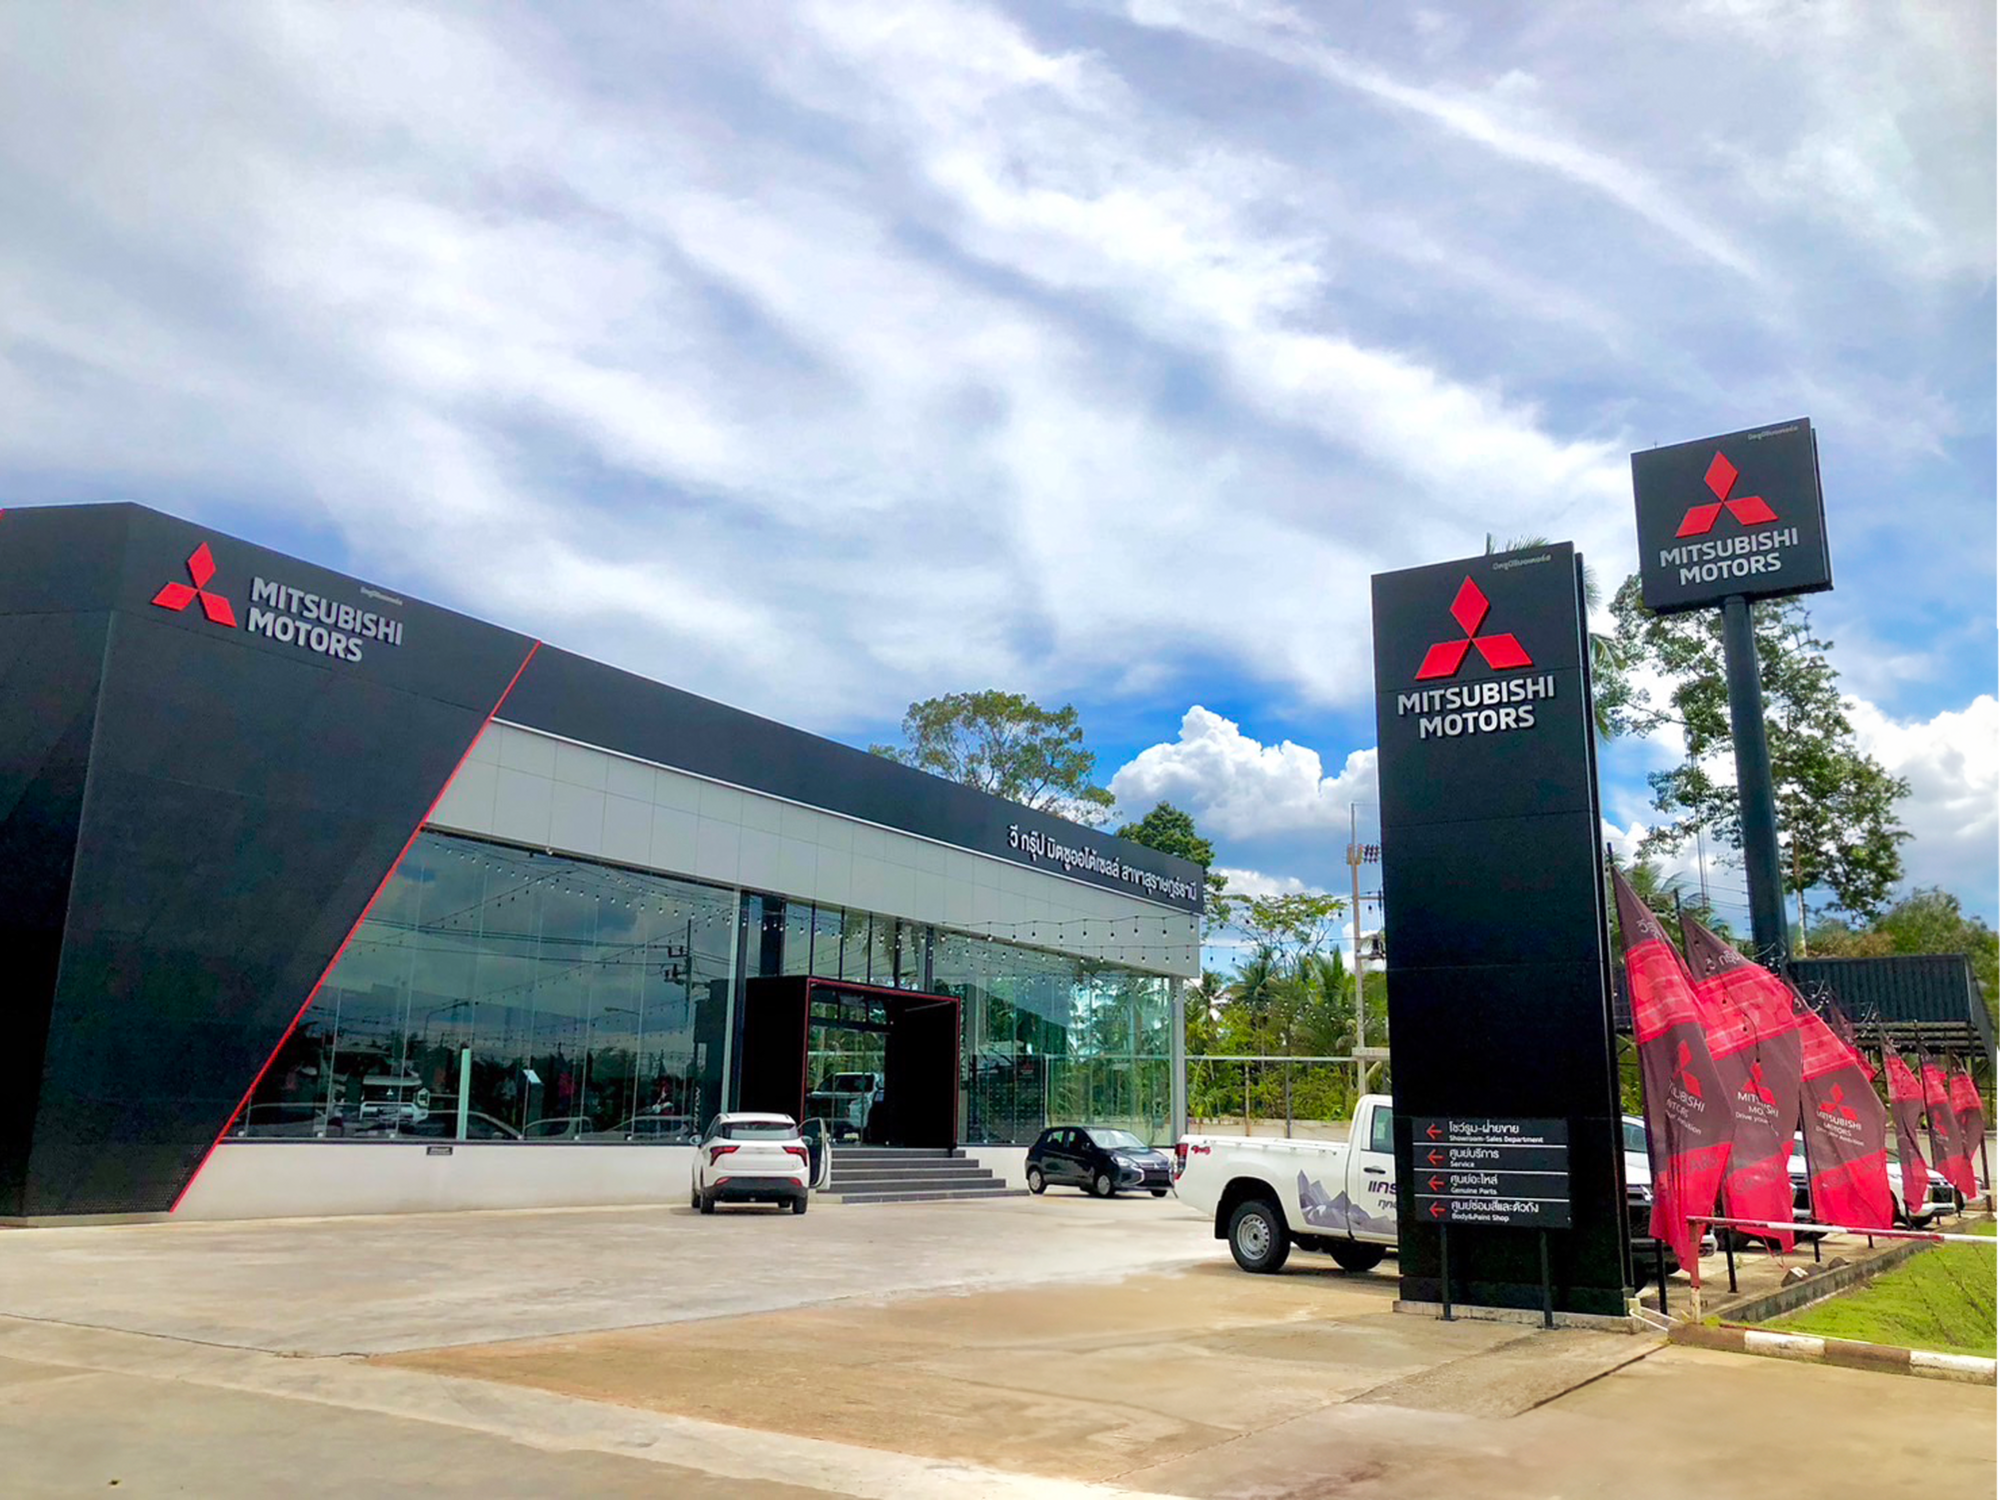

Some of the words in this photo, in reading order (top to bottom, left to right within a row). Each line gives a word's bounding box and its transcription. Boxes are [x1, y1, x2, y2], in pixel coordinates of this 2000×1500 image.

[1659, 527, 1799, 568] MITSUBISHI
[1679, 552, 1782, 586] MOTORS
[251, 576, 404, 646] MITSUBISHI
[247, 607, 364, 663] MOTORS
[1397, 675, 1556, 716] MITSUBISHI
[1419, 705, 1536, 740] MOTORS
[1009, 824, 1019, 848] วี
[1020, 830, 1045, 862] กรุ๊ป
[1449, 1147, 1500, 1160] ศูนย์บริการ
[1503, 1135, 1544, 1144] Department
[1449, 1160, 1475, 1168] Service
[1449, 1173, 1498, 1187] ศูนย์อะไหล่
[1450, 1187, 1478, 1195] Genuine
[1478, 1187, 1498, 1195] Parts
[1491, 1214, 1510, 1223] Shop
